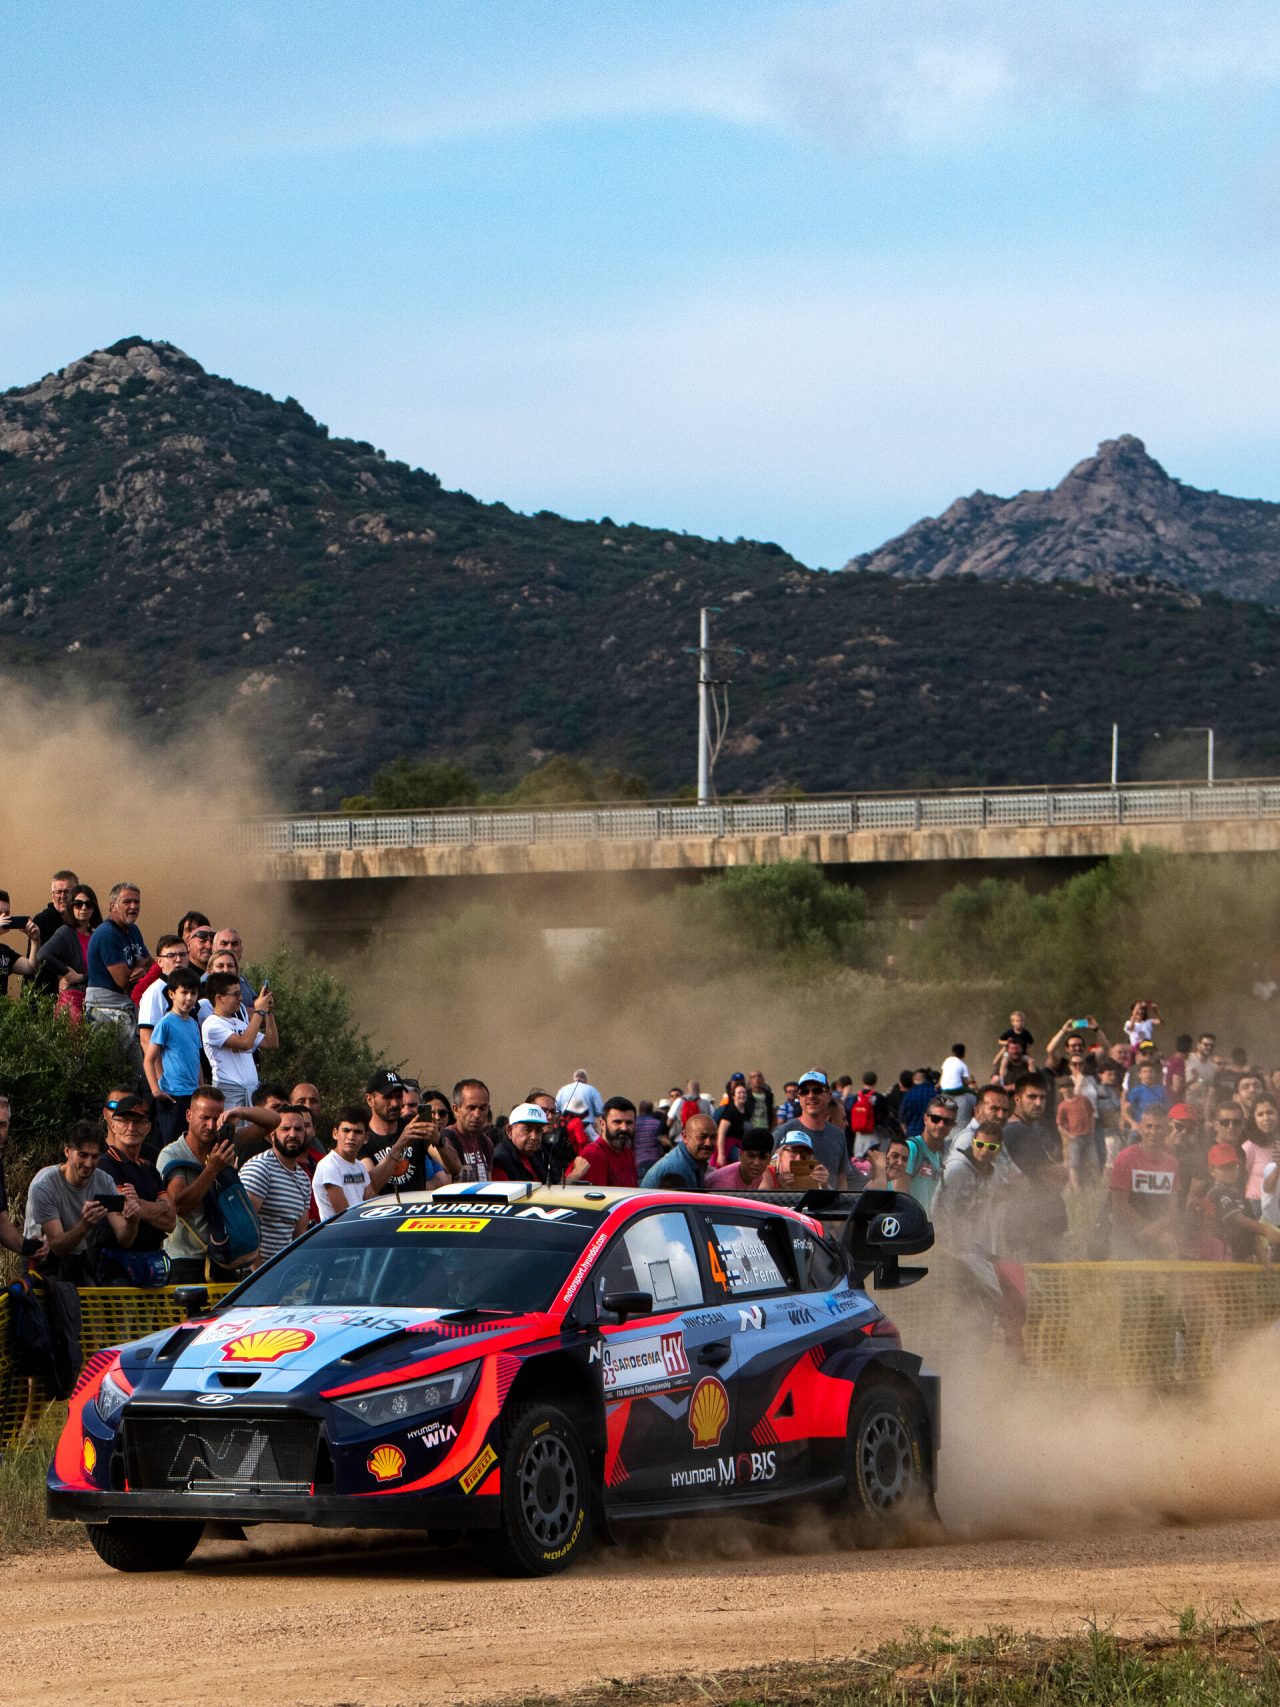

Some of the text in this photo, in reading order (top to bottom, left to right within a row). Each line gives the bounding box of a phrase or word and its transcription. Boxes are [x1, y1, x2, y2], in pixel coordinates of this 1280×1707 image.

[1135, 1174, 1171, 1191] FILA
[406, 1203, 577, 1220] HYUNDAI N
[408, 1220, 481, 1230] PIRELLI
[563, 1233, 608, 1303] motorsport.hyundai.com
[706, 1240, 728, 1292] 4
[743, 1240, 770, 1261] Lappi
[743, 1267, 779, 1284] J. Ferm
[839, 1300, 859, 1312] STEEL
[272, 1313, 409, 1331] MOBIS
[682, 1312, 726, 1328] INNOCEAN
[738, 1305, 766, 1332] N
[788, 1306, 816, 1326] WIA
[612, 1350, 662, 1372] SARDEGNA
[662, 1336, 686, 1373] HY
[623, 1387, 635, 1396] World
[635, 1385, 645, 1394] Rally
[644, 1381, 671, 1393] Championship
[407, 1421, 440, 1439] HYUNDAI
[421, 1424, 458, 1449] WIA
[463, 1450, 493, 1489] PIRELLI
[671, 1450, 777, 1488] HYUNDAI MOBIS
[543, 1507, 585, 1561] SCORPION
